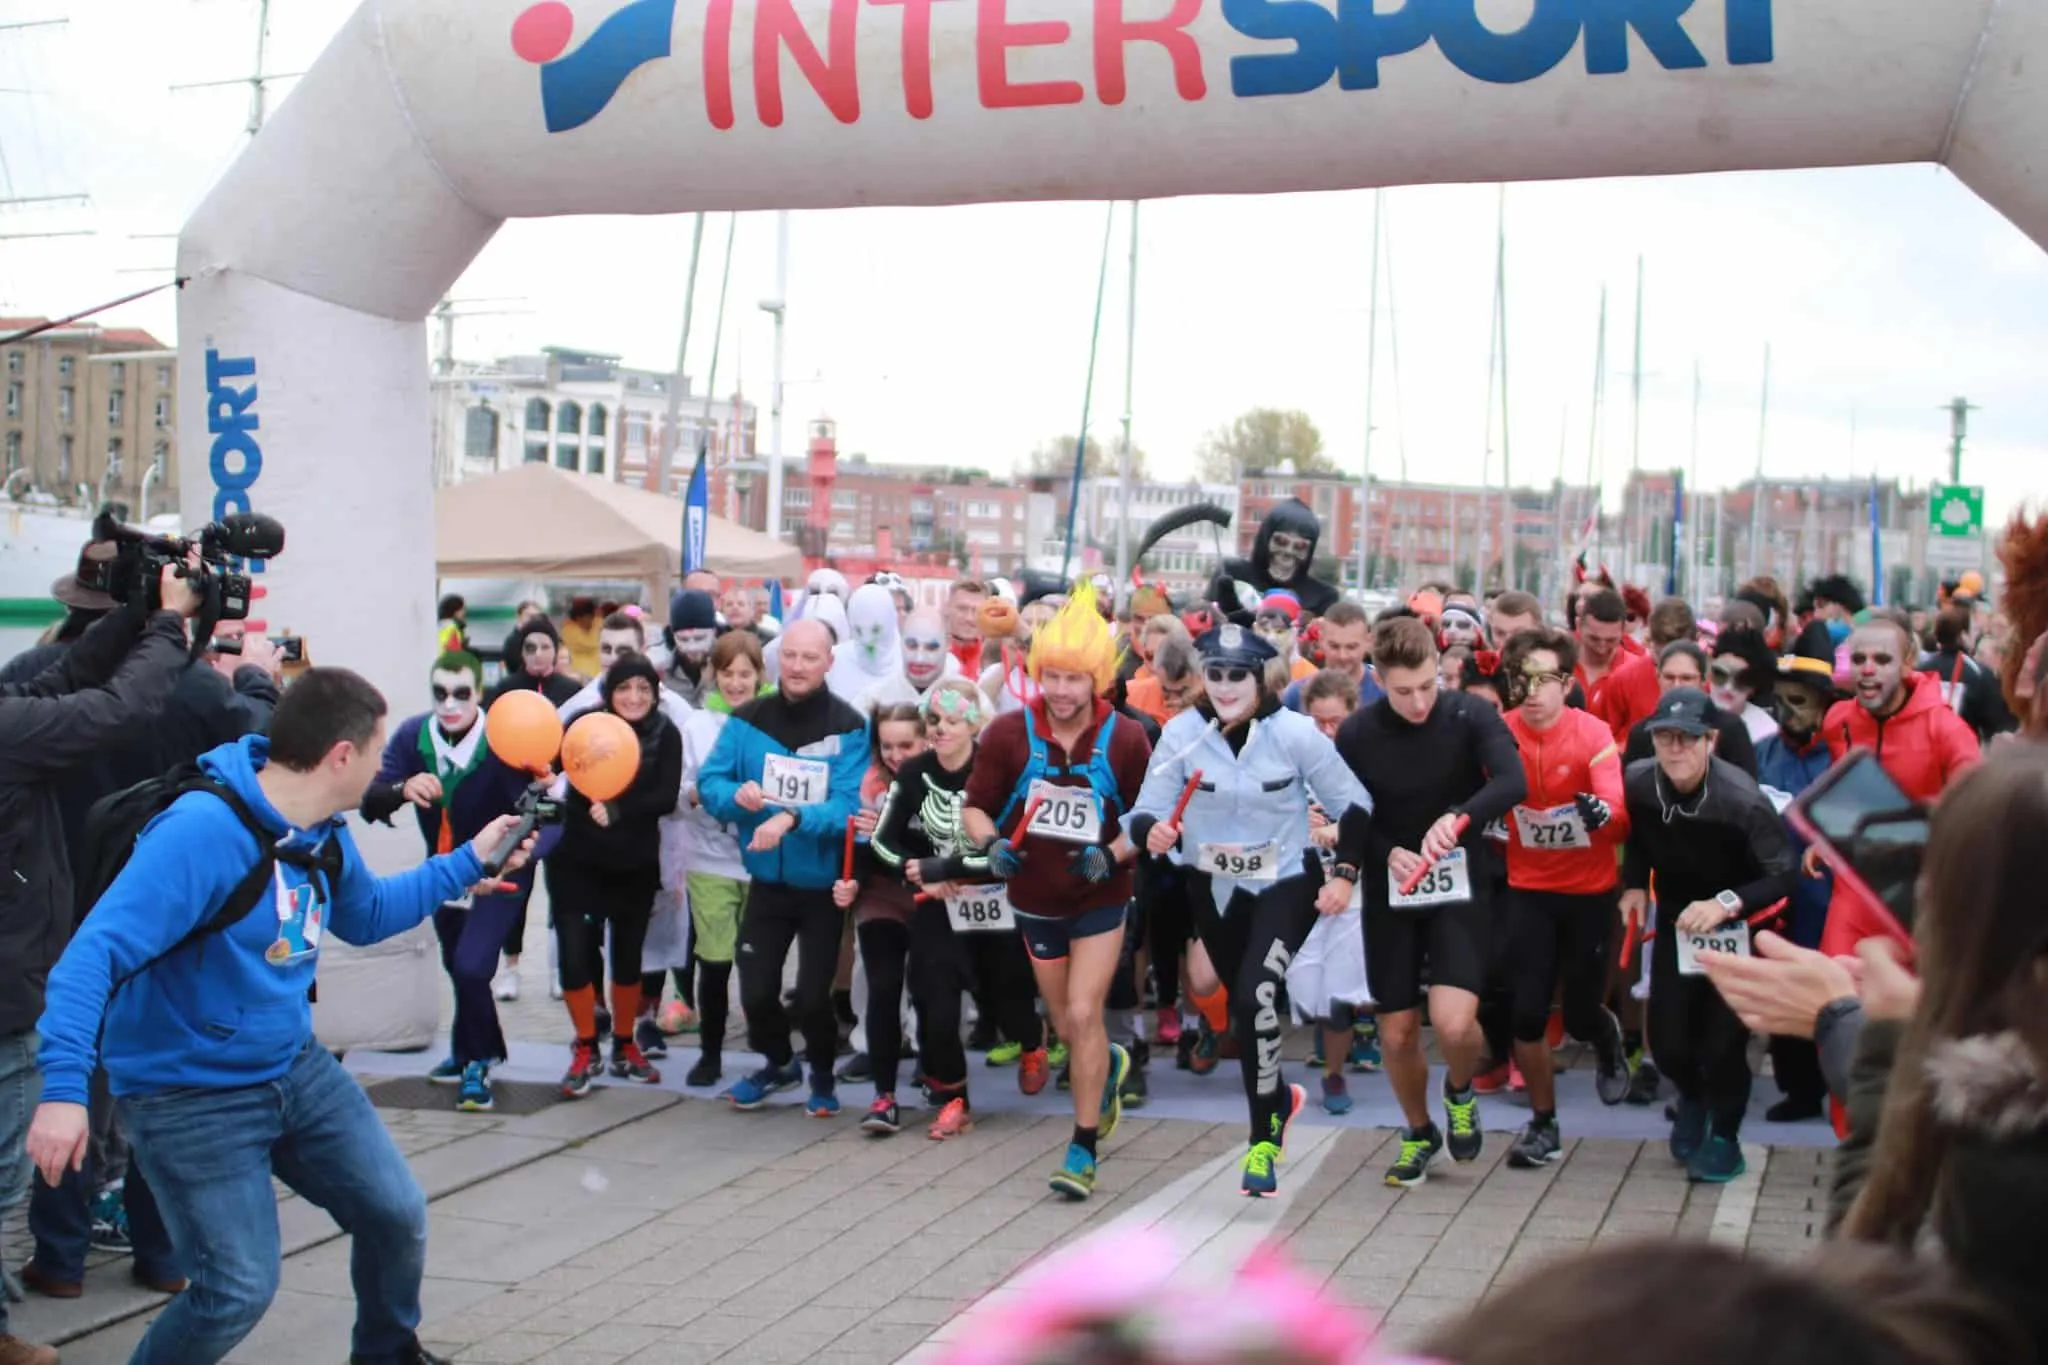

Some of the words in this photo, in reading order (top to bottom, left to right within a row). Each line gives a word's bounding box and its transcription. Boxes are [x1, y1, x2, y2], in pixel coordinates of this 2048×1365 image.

[776, 773, 809, 801] 191
[1035, 797, 1088, 829] 205
[1530, 821, 1576, 844] 272
[1214, 853, 1262, 874] 498
[959, 898, 1001, 922] 488
[1254, 981, 1279, 1031] DO
